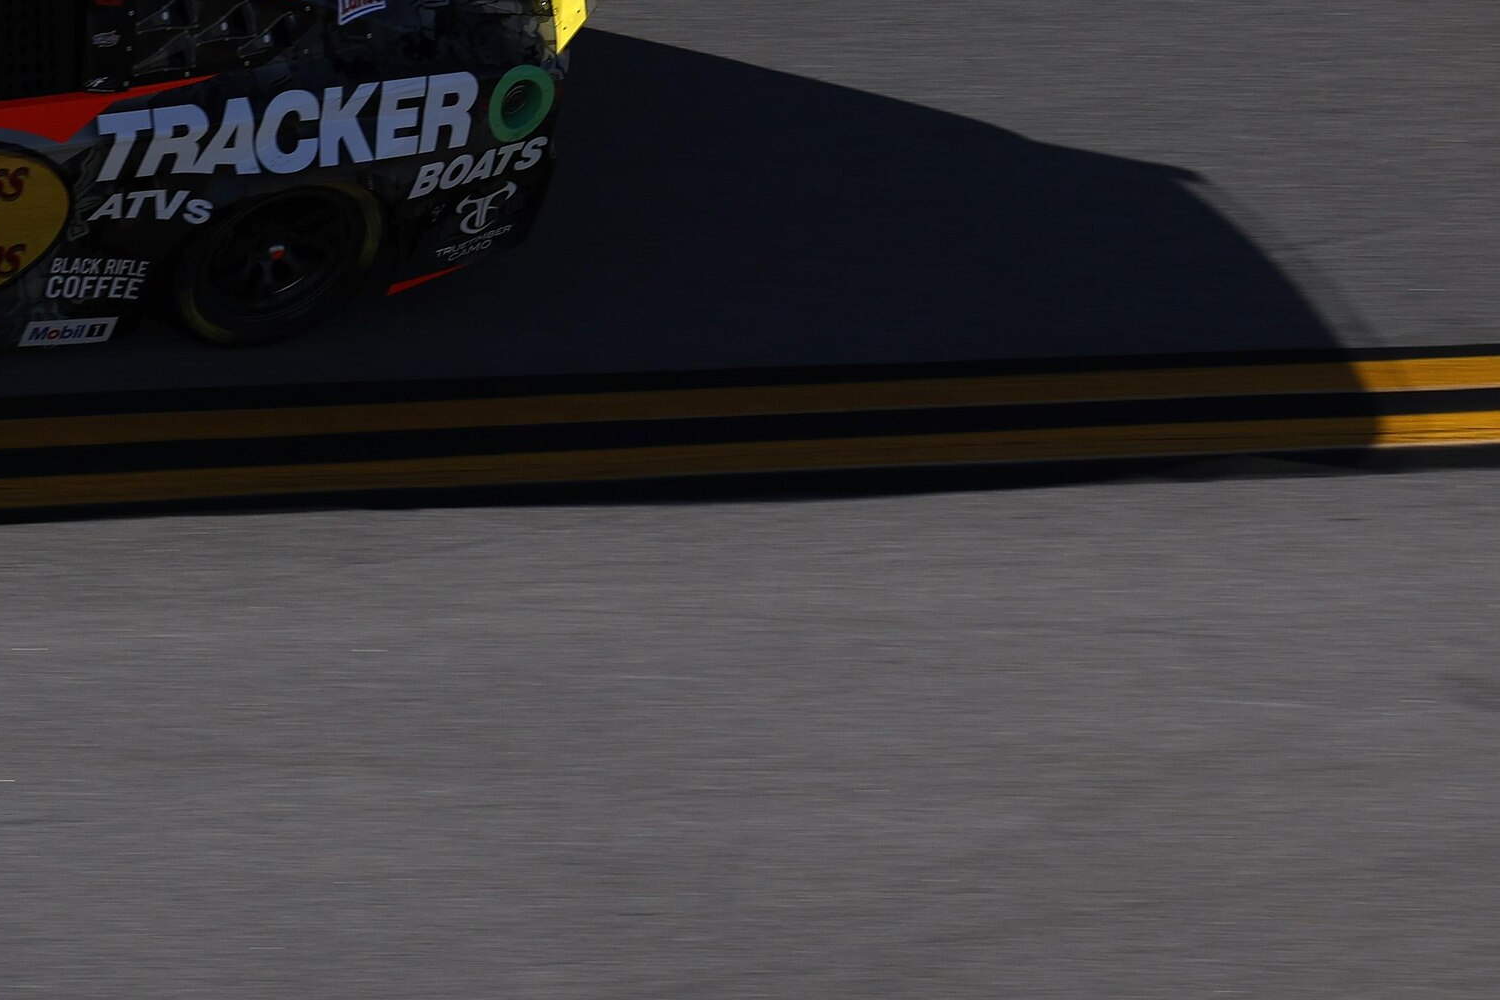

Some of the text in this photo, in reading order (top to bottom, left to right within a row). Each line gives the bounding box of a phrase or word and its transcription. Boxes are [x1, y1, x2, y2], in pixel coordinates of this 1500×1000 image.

[95, 70, 480, 183] TRACKER
[406, 135, 549, 200] BOATS
[86, 188, 215, 225] ATVs
[50, 256, 150, 277] BLACK RIFLE
[45, 274, 147, 300] COFFEE
[29, 324, 87, 341] Mobil
